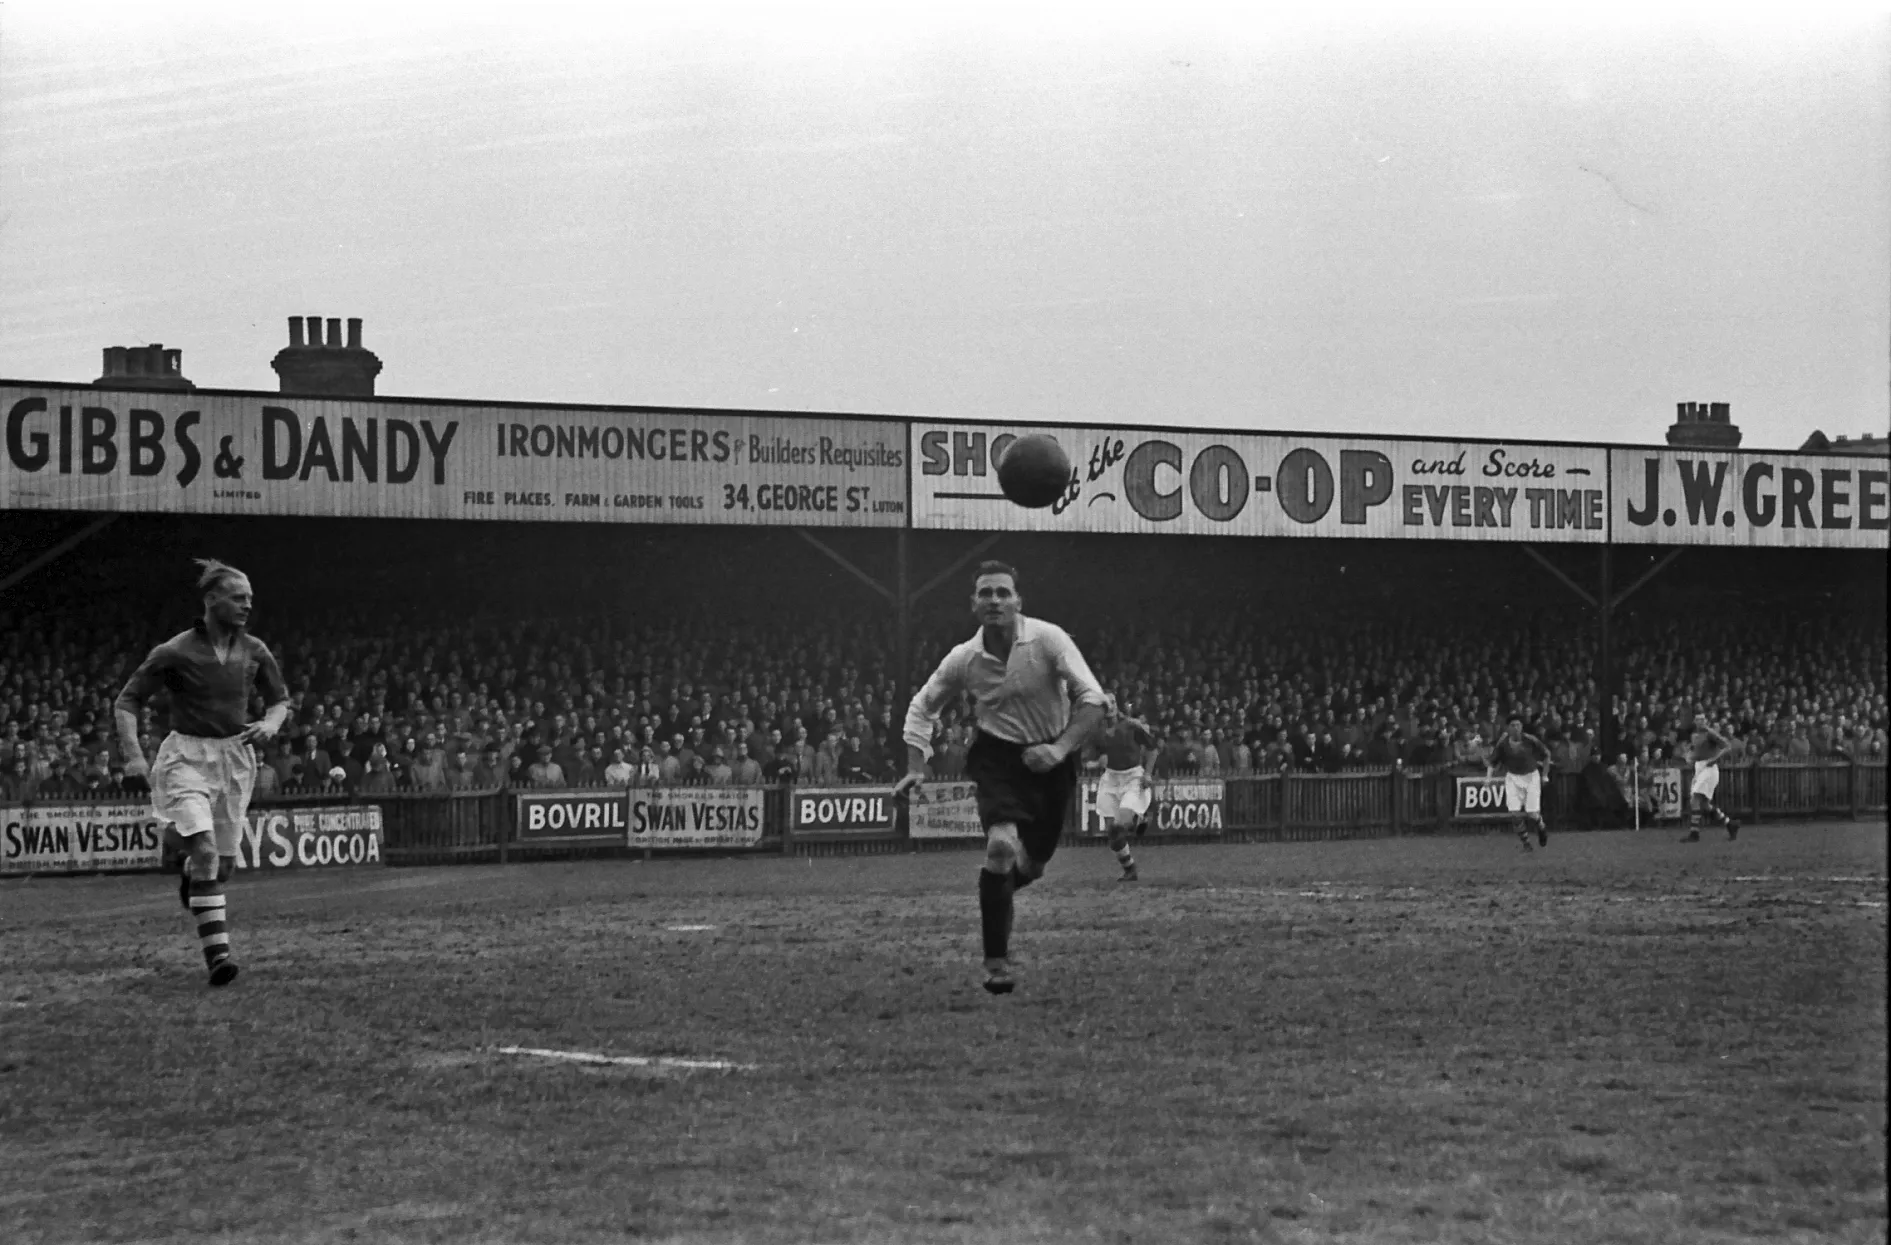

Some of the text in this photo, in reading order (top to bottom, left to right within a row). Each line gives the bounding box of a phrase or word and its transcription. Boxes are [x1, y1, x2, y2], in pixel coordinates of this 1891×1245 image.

[6, 397, 459, 488] GIBBS & DANDY
[498, 423, 730, 462] IRONMONGERS
[820, 436, 903, 472] Requisites
[1087, 436, 1124, 482] the
[1411, 449, 1556, 477] and Score
[213, 490, 262, 500] LIMITED
[1123, 440, 1393, 524] CO-OP
[463, 491, 495, 505] FIRE
[565, 493, 600, 507] FARM
[613, 494, 662, 508] GARDEN
[668, 495, 703, 509] TOOLS
[757, 483, 838, 511] GEORGE
[872, 501, 903, 513] LUTON
[1402, 484, 1603, 530] EVERY TIME
[801, 798, 888, 823] BOVRIL
[1465, 785, 1506, 808] BOV
[20, 811, 39, 819] THE
[108, 809, 145, 817] MATCH
[529, 802, 625, 830] BOVRIL
[633, 801, 759, 833] SWAN VESTAS
[1157, 803, 1222, 829] COCOA
[6, 821, 158, 858] SWAN VESTAS
[298, 833, 380, 865] COCOA
